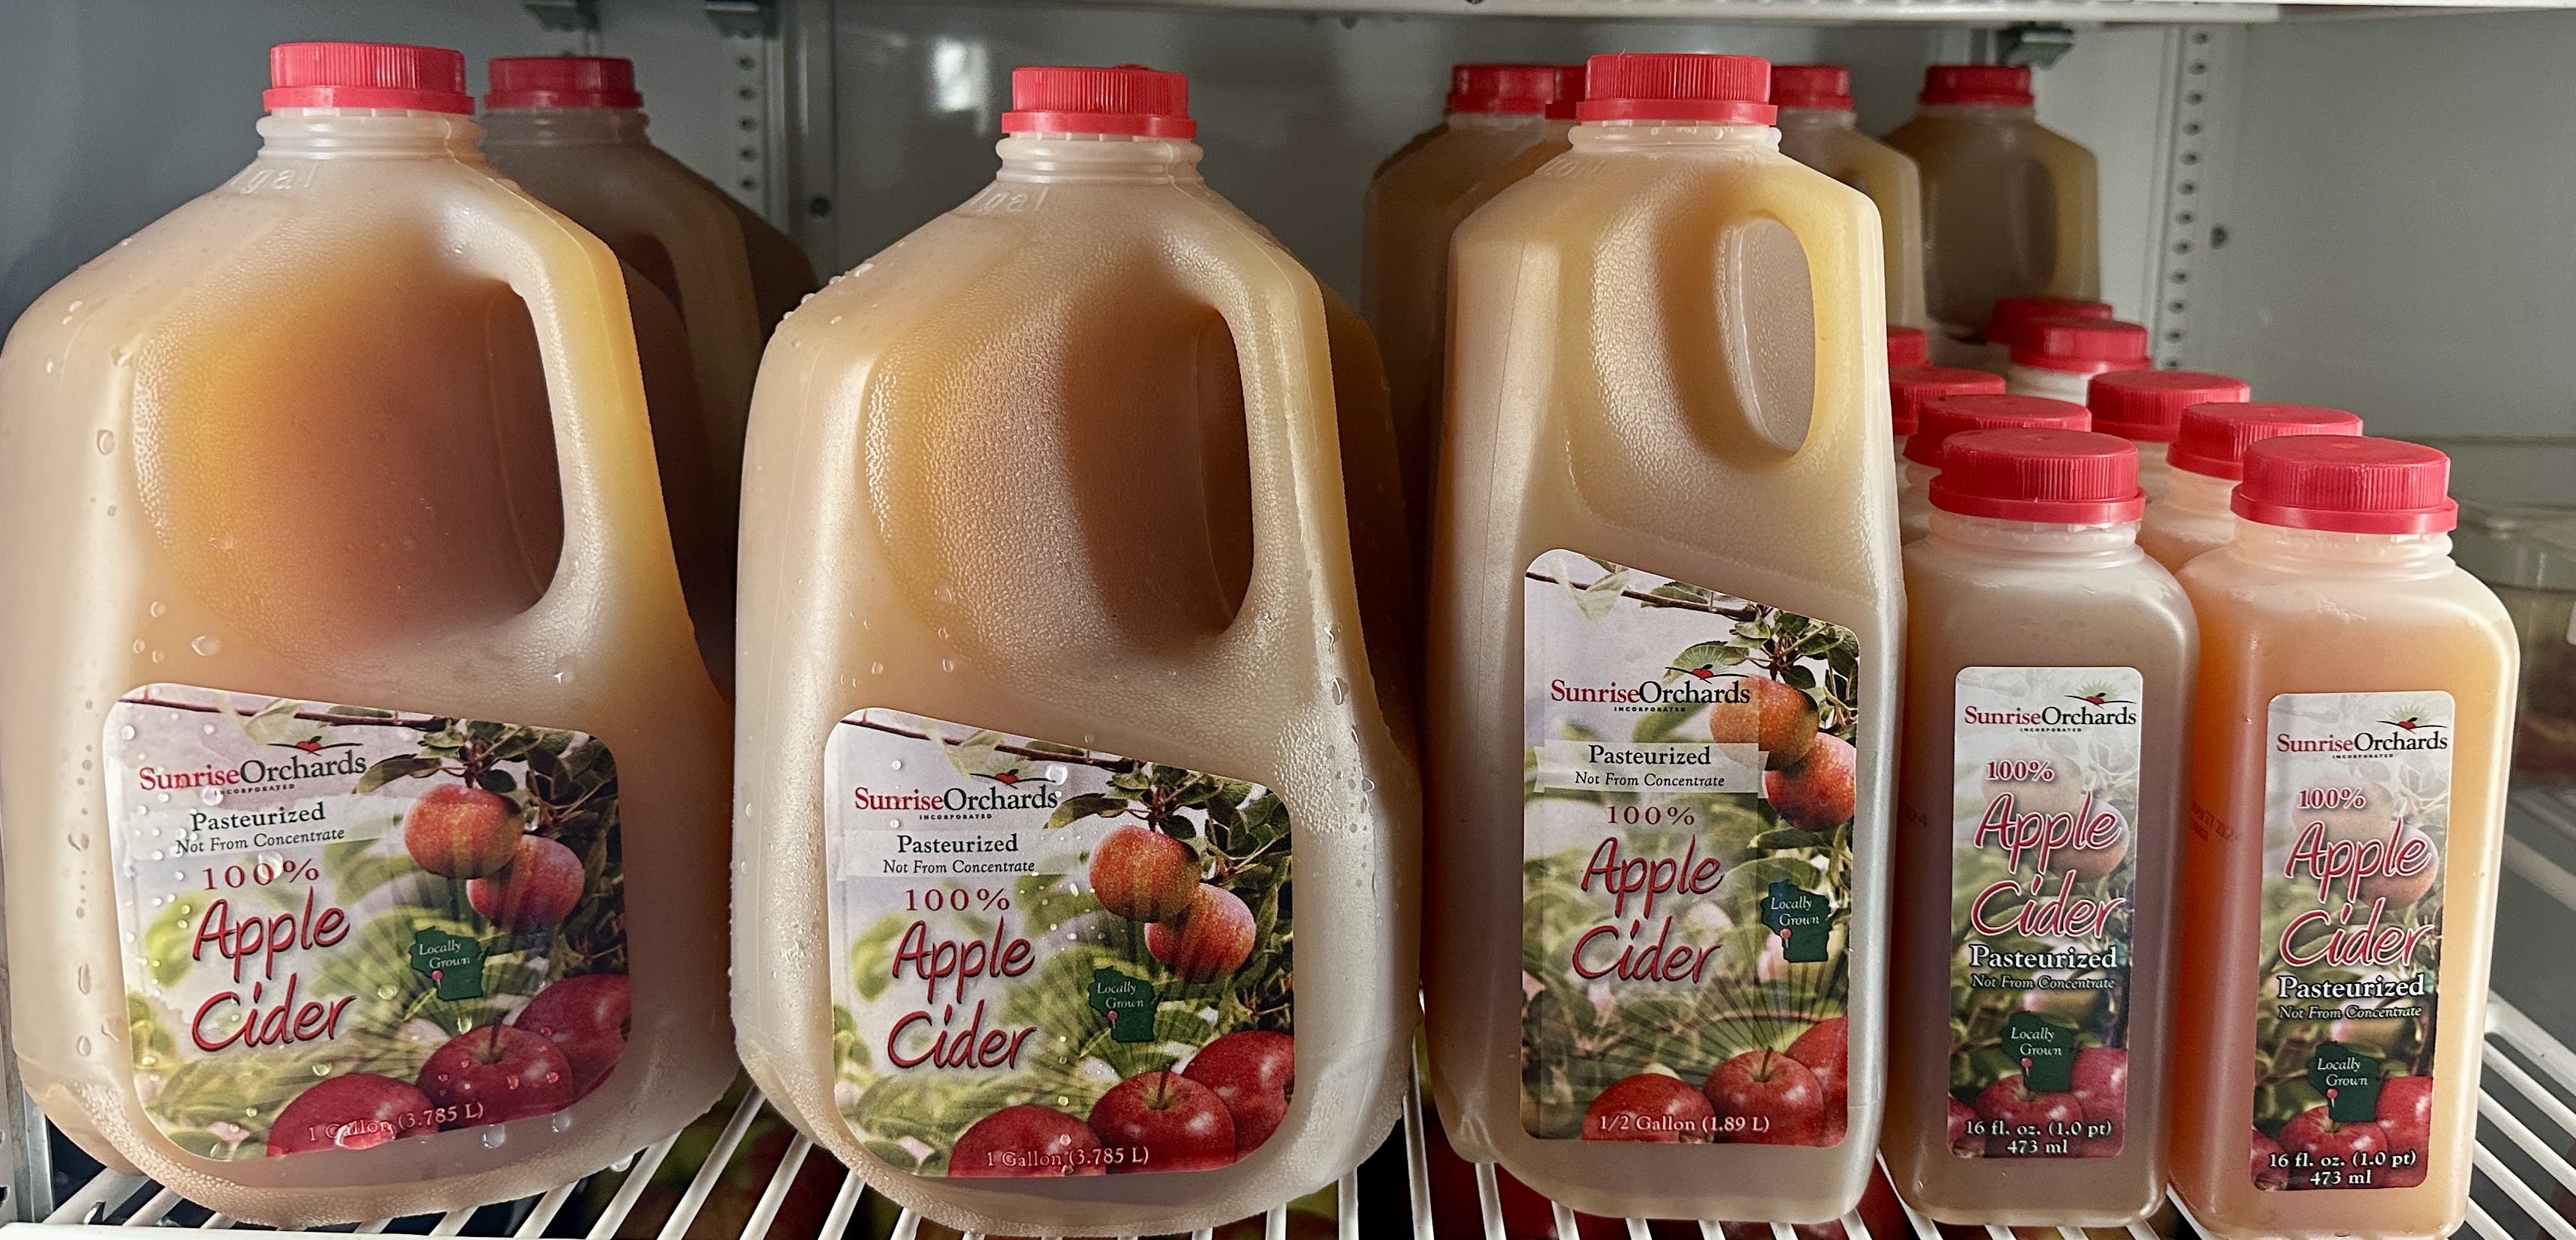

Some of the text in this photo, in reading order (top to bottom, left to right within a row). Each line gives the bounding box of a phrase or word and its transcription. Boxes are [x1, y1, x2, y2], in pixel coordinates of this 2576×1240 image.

[1551, 679, 1751, 704] SunriseOrchards
[1964, 705, 2136, 726] SunriseOrchards
[2276, 731, 2448, 752] SunriseOrchards
[1588, 744, 1711, 765] Pasteurized
[139, 750, 367, 791] SunriseOrchards
[1575, 771, 1725, 787] Not From Concentrate
[1987, 760, 2055, 781] 100%
[854, 785, 1058, 811] SunriseOrchards
[2298, 788, 2366, 809] 100%
[189, 801, 326, 832] Pasteurized
[1608, 806, 1695, 825] 100%
[175, 829, 345, 854] Not From Concentrate
[1973, 789, 2122, 875] Apple
[897, 833, 1018, 854] Pasteurized
[883, 860, 1035, 874] Not From Concentrate
[2284, 816, 2432, 904] Apple
[202, 858, 320, 890] 100%
[1581, 834, 1724, 920] Apple
[905, 888, 1010, 912] 100%
[1770, 896, 1812, 911] Locally
[1971, 869, 2127, 938] Cider
[1779, 914, 1819, 927] Grown
[192, 886, 350, 983] Apple
[2279, 896, 2435, 967] Cider
[419, 940, 461, 955] Locally
[1573, 915, 1723, 983] Cider
[1970, 944, 2118, 968] Pasteurized
[429, 956, 470, 969] Grown
[892, 915, 1036, 1005] Apple
[1097, 981, 1137, 994] Locally
[1971, 973, 2115, 990] Not From Concentrate
[2278, 973, 2425, 998] Pasteurized
[192, 973, 356, 1052] Cider
[1105, 997, 1144, 1009] Grown
[2279, 1005, 2422, 1019] Not From Concentrate
[887, 998, 1037, 1069] Cider
[2011, 1027, 2055, 1042] Locally
[2020, 1043, 2062, 1056] Grown
[2318, 1057, 2360, 1072] Locally
[2326, 1074, 2368, 1086] Grown
[309, 1104, 484, 1142] 1 Gallon (3.785 L)
[1600, 1115, 1770, 1133] 1/2 Gallon (1.89 L)
[1966, 1121, 2112, 1137] 16 fl. oz. (1.0 pt)
[988, 1146, 1149, 1167] 1 Gallon (3.785 L)
[2007, 1139, 2068, 1153] 473 ml
[2270, 1150, 2416, 1167] 16 fl. oz. (1.0 pt)
[2309, 1170, 2372, 1185] 473 ml
